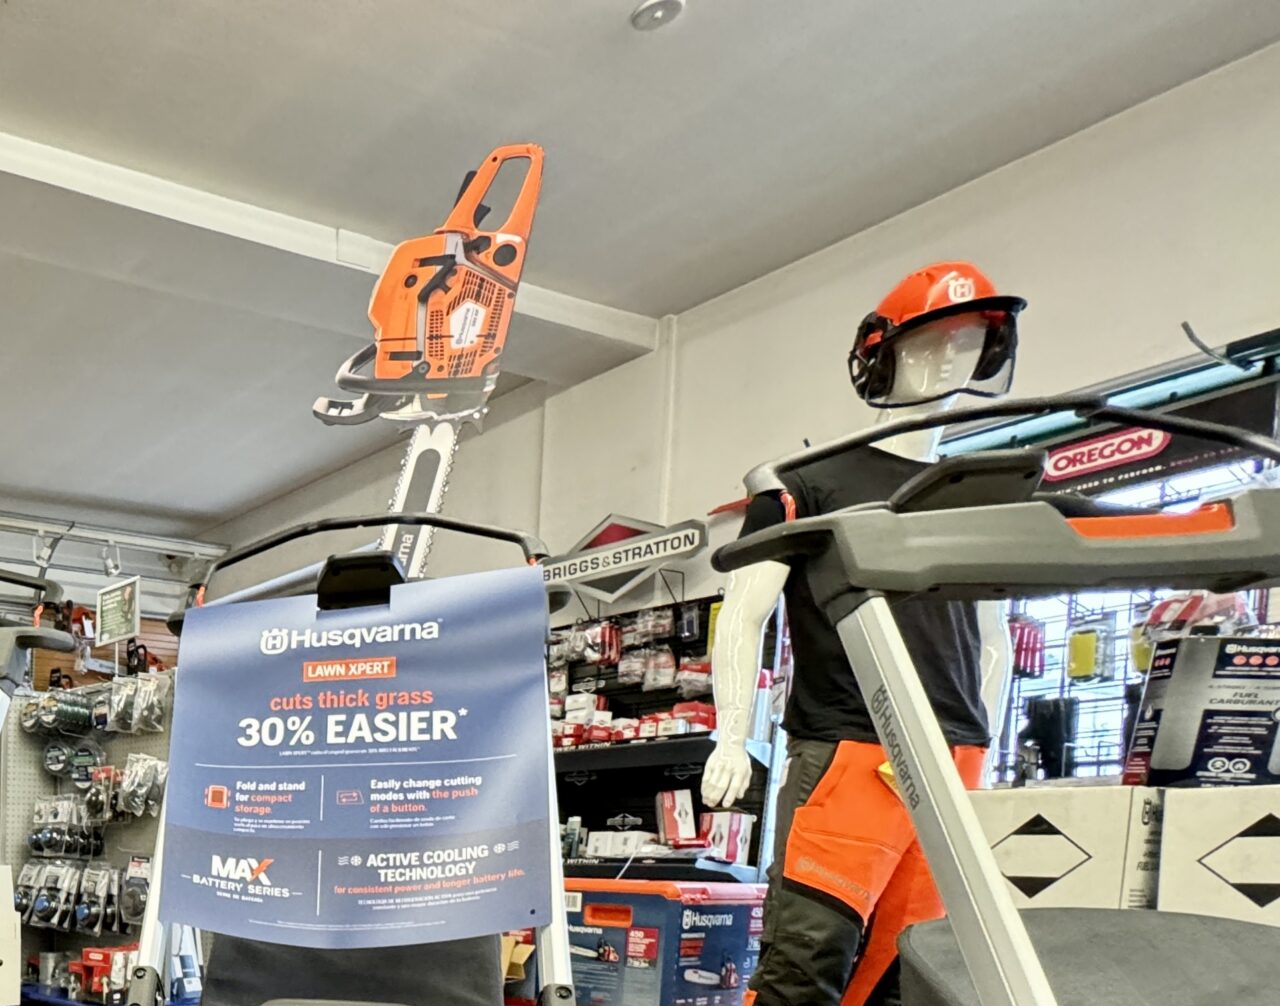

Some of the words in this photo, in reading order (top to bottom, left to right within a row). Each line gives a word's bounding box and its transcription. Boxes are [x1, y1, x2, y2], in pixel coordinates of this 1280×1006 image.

[1053, 432, 1153, 471] OREGON
[291, 620, 439, 649] Husqvarna
[307, 663, 345, 678] LAWN
[348, 661, 390, 675] XPERT
[270, 693, 313, 711] cuts
[318, 689, 369, 708] thick
[376, 690, 433, 709] grass
[237, 715, 315, 747] 30%
[879, 705, 920, 810] Husqvarna
[236, 781, 256, 791] Fold
[258, 782, 276, 791] and
[278, 781, 305, 791] stand
[370, 779, 401, 790] Easily
[403, 778, 442, 790] change
[444, 775, 482, 788] cutting
[235, 792, 249, 802] for
[250, 793, 292, 802] compact
[370, 790, 404, 801] modes
[407, 789, 430, 800] with
[432, 789, 451, 799] the
[453, 787, 478, 799] push
[370, 803, 381, 813] of
[366, 853, 420, 868] ACTIVE
[423, 845, 489, 864] COOLING
[211, 854, 275, 886] MAX
[378, 862, 476, 883] TECHNOLOGY
[192, 873, 243, 892] BATTERY
[247, 884, 290, 898] SERIES
[334, 885, 346, 895] for
[348, 885, 393, 894] consistent
[394, 883, 421, 894] power
[423, 880, 442, 891] and
[442, 878, 471, 890] longer
[473, 872, 506, 885] battery
[692, 911, 733, 929] Husqvarna
